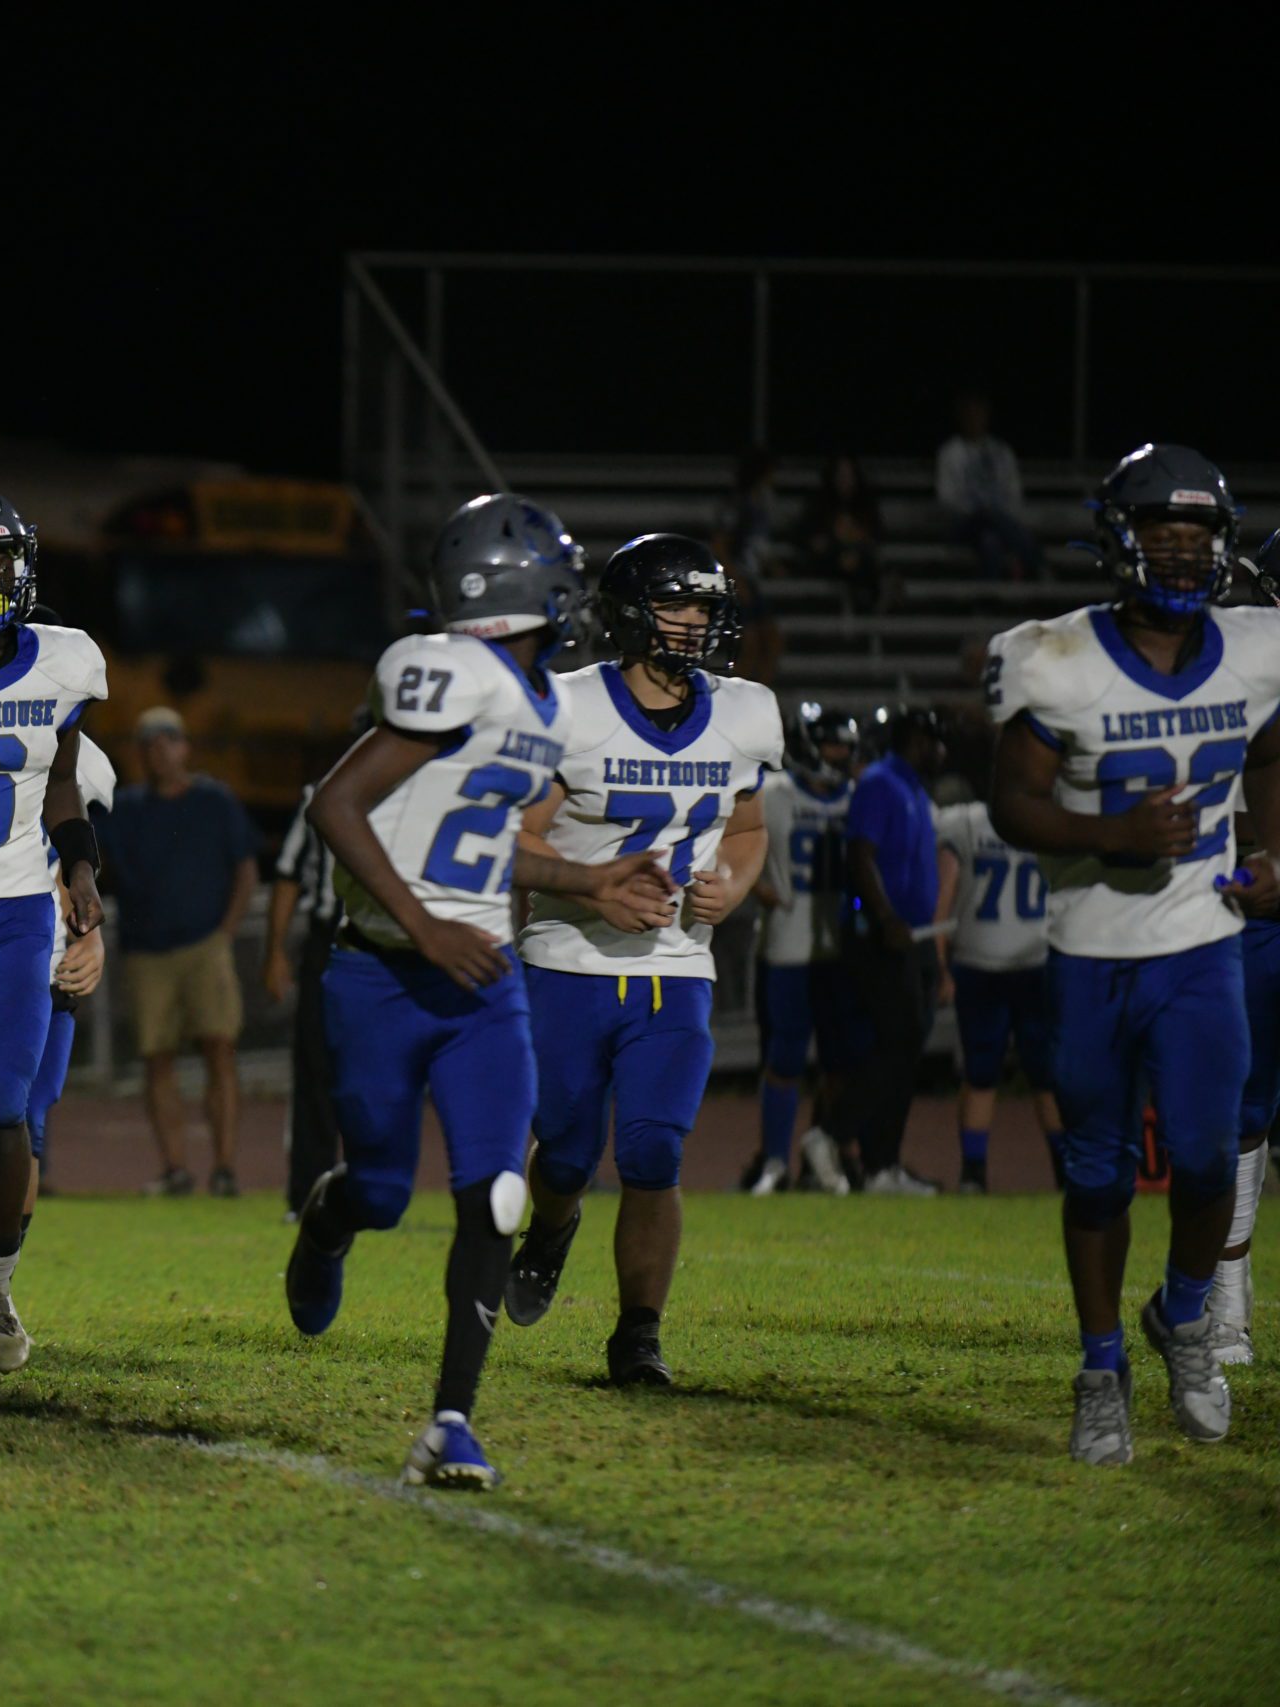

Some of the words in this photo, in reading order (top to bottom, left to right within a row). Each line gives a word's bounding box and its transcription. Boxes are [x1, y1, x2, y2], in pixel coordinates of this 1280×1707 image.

[395, 665, 453, 714] 27
[1102, 699, 1248, 743] LIGHTHOUSE
[603, 757, 732, 788] LIGHTHOUSE
[604, 789, 720, 887] 71
[974, 857, 1049, 920] 70
